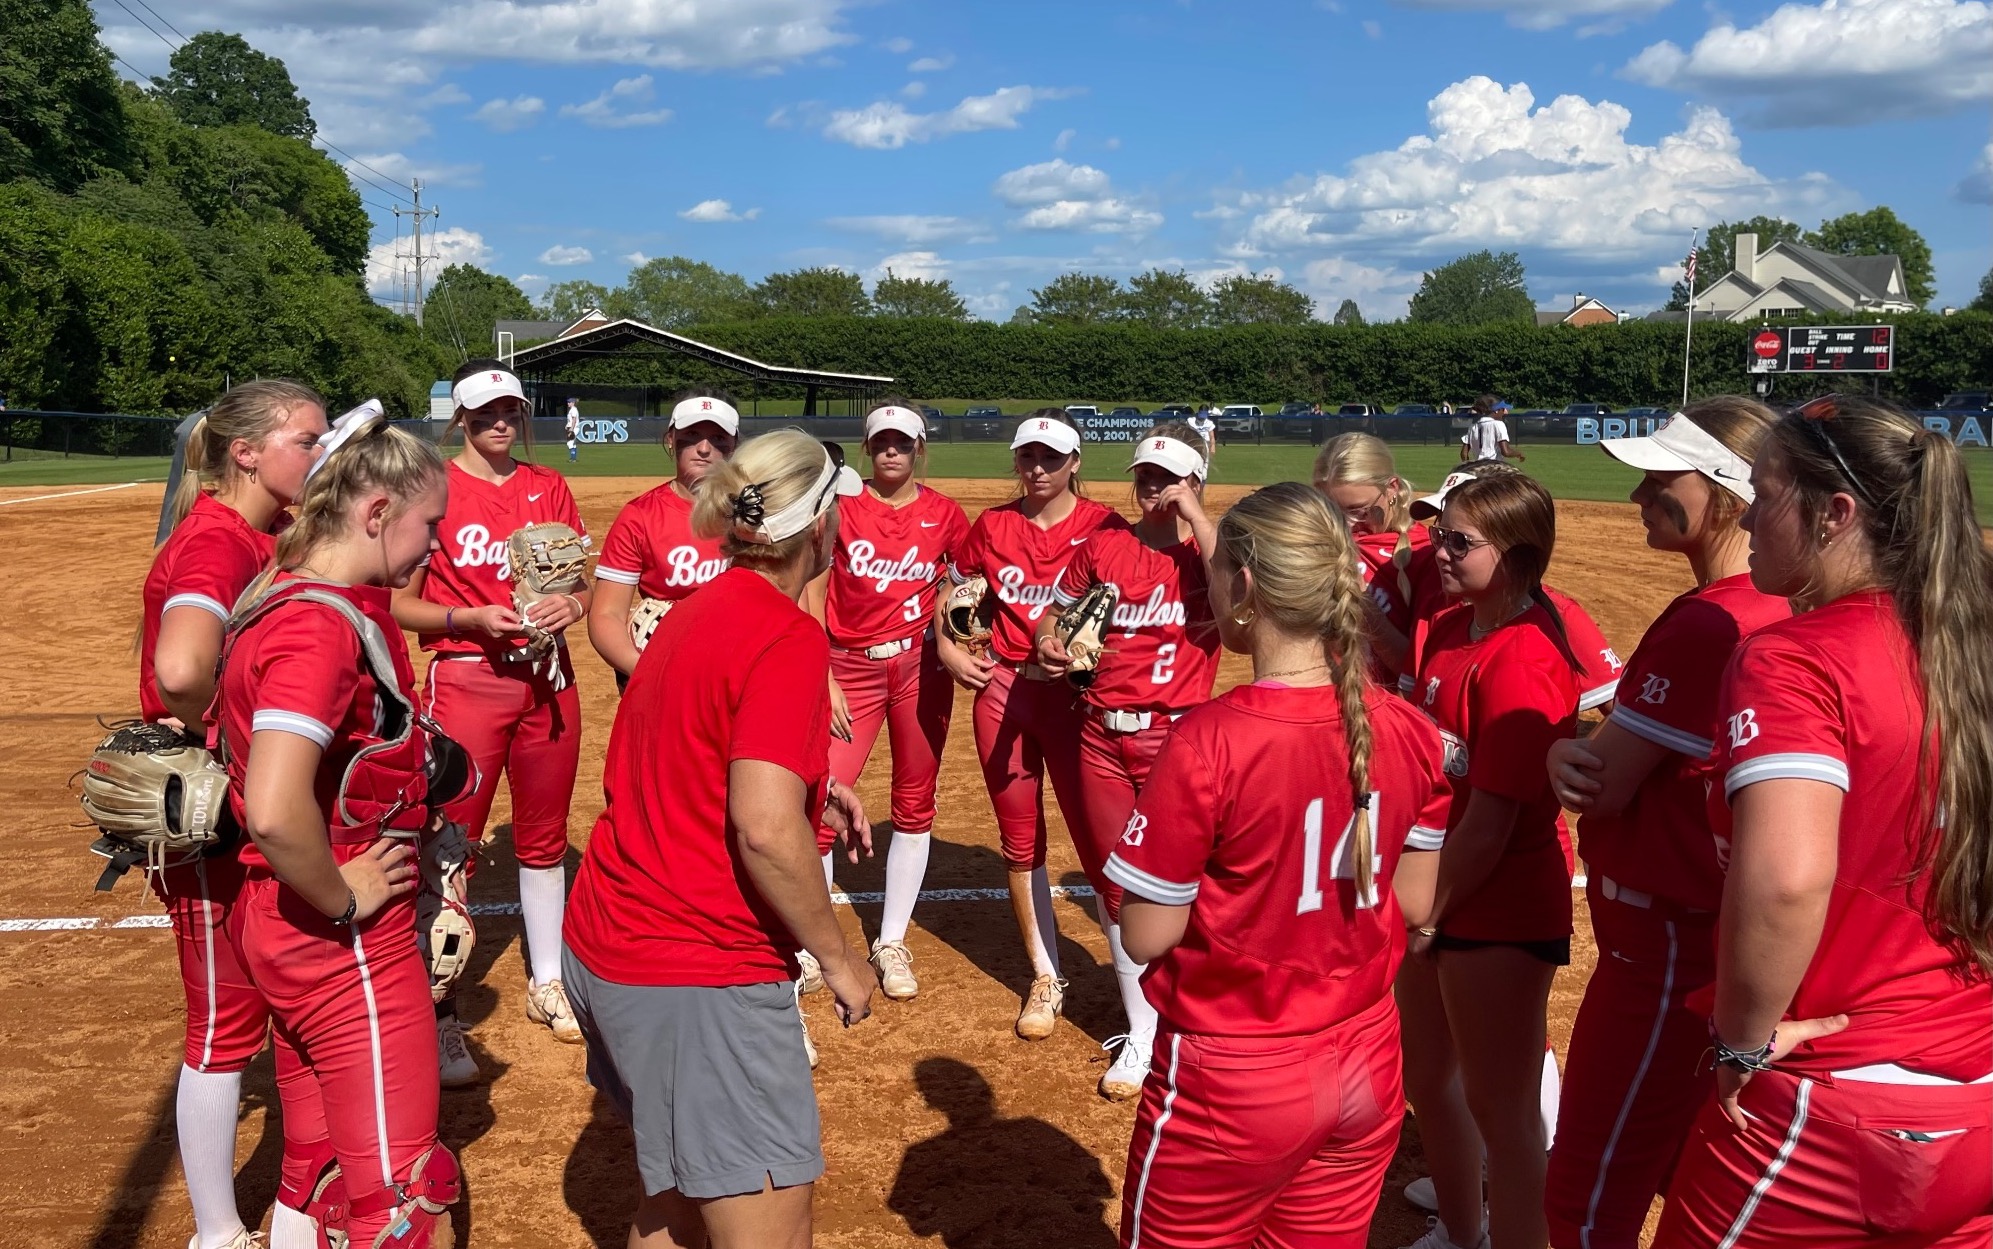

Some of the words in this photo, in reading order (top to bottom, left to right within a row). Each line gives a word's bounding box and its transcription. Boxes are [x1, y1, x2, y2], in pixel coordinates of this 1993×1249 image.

[1836, 333, 1856, 341] TIME
[1789, 346, 1817, 354] GUEST
[1825, 346, 1855, 354] INNING
[1863, 345, 1889, 354] HOME
[1803, 354, 1814, 369] 3
[576, 419, 629, 443] GPS
[1038, 420, 1049, 431] B
[1086, 418, 1155, 428] CHAMPIONS
[1083, 431, 1101, 442] 00,
[1103, 431, 1133, 442] 2001,
[1153, 440, 1166, 451] B
[847, 539, 937, 593] Baylor
[1151, 643, 1177, 684] 2
[1635, 672, 1671, 704] B
[1726, 708, 1760, 759] B
[191, 776, 214, 828] Wilson
[1118, 808, 1148, 847] B
[1296, 790, 1383, 917] 14
